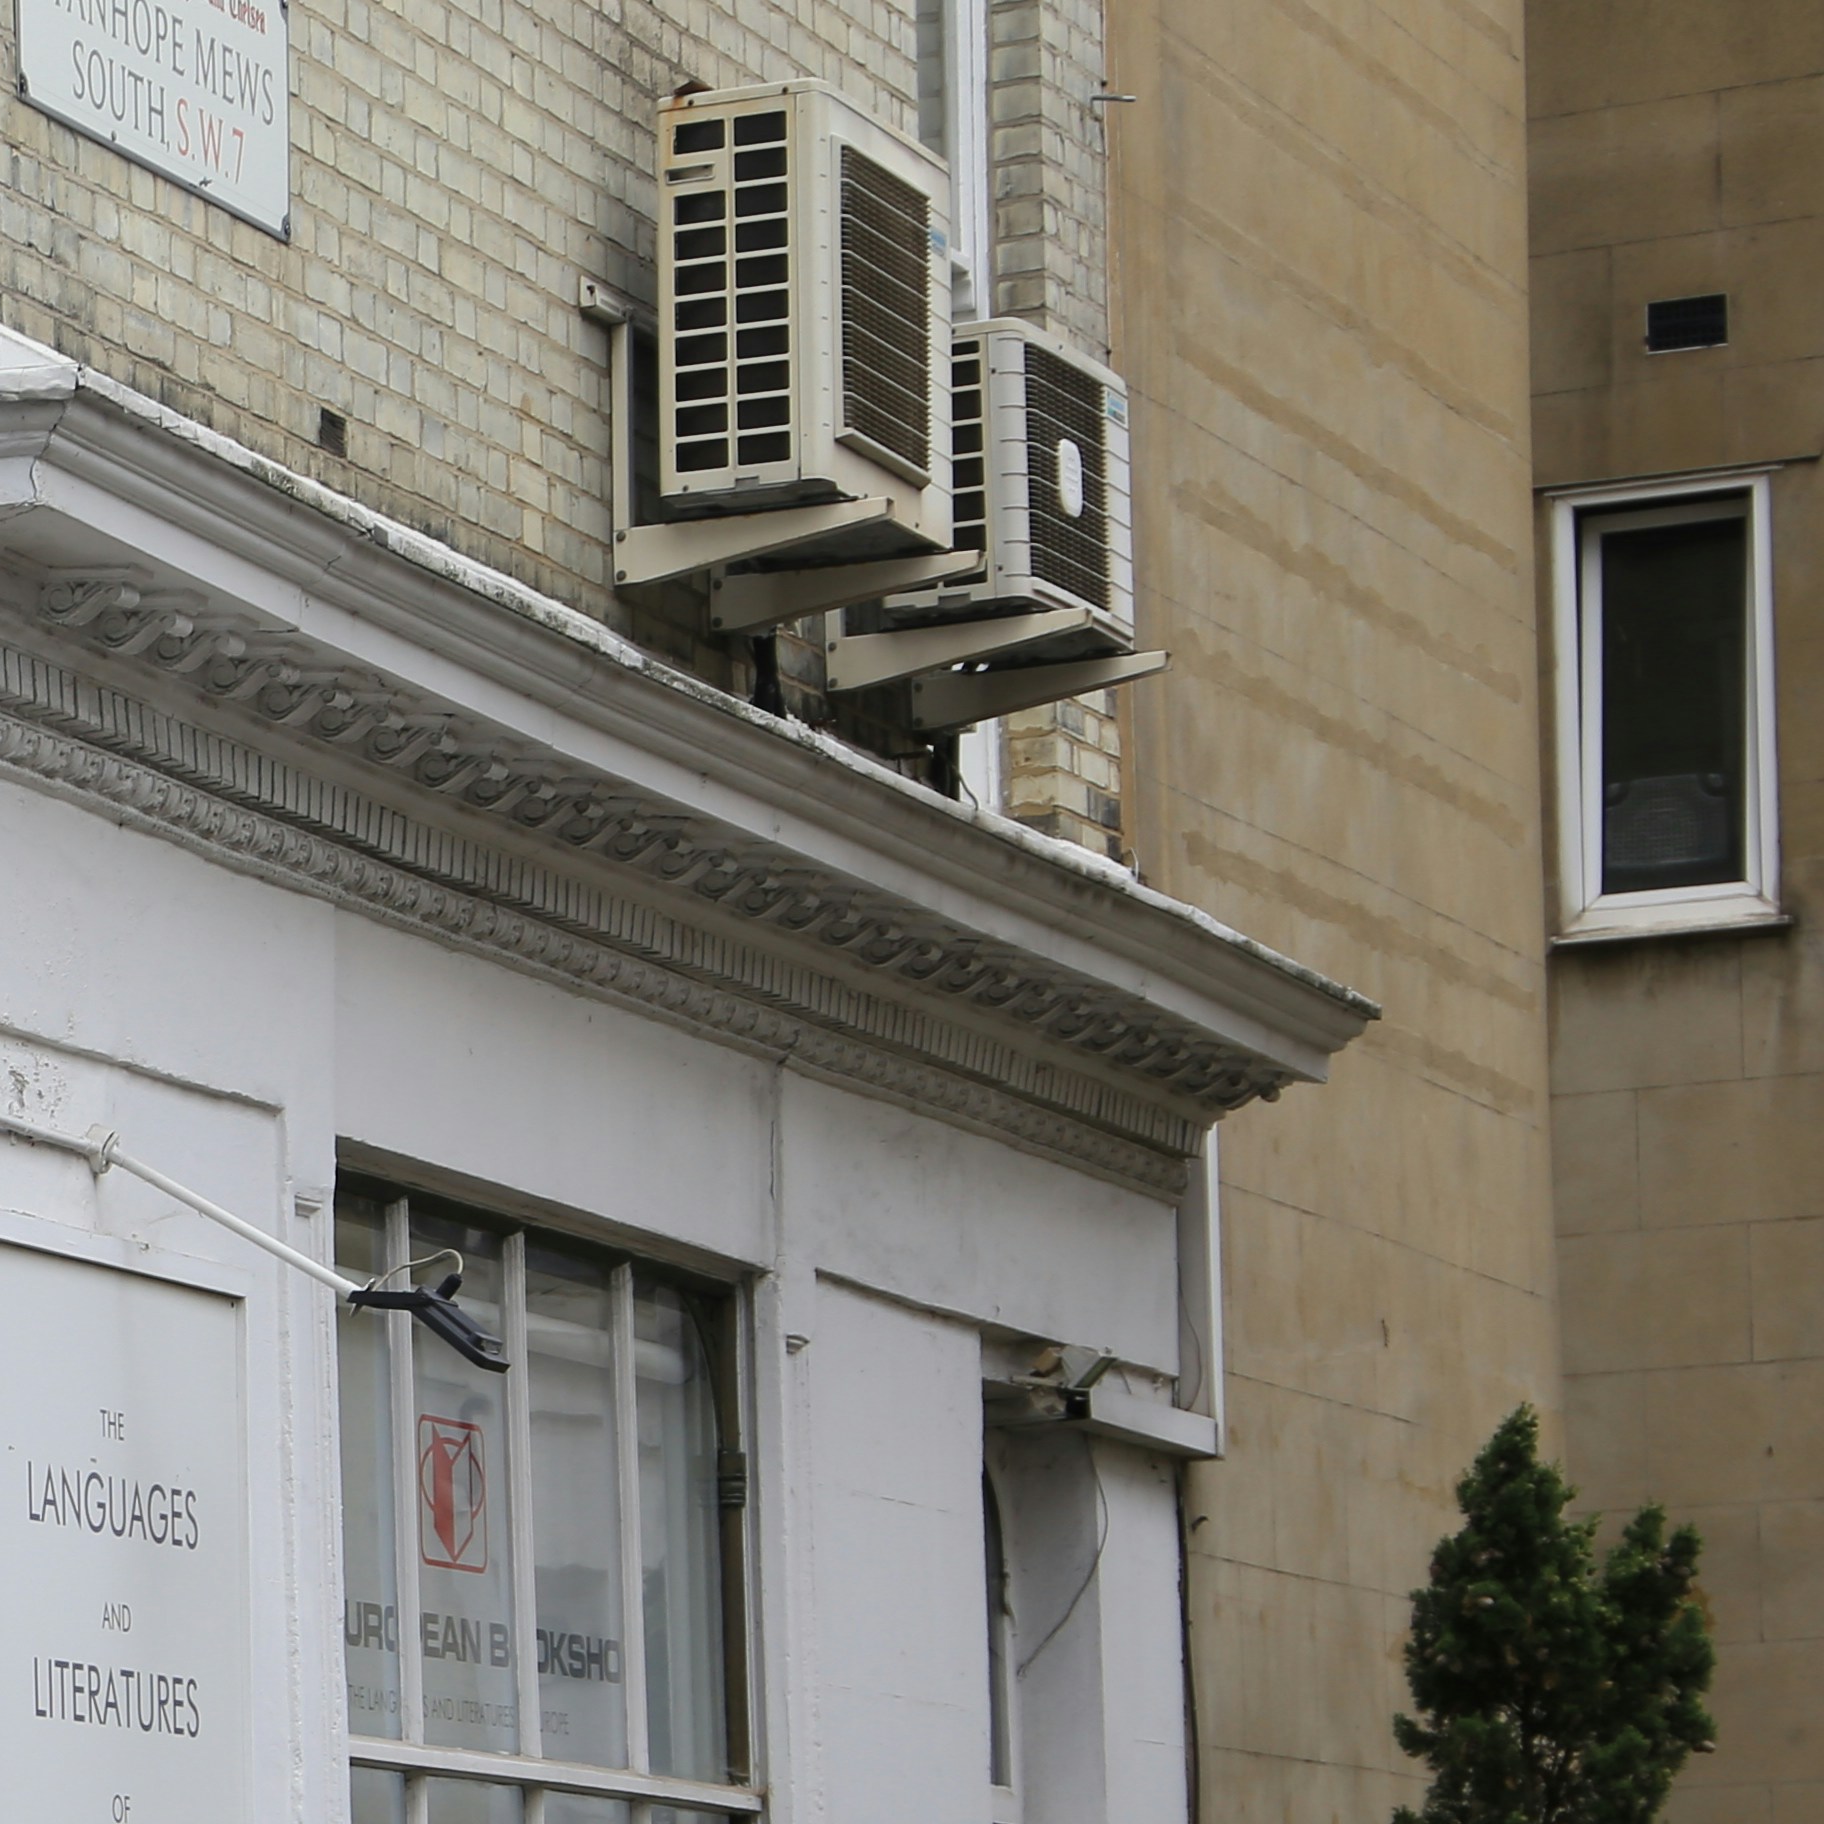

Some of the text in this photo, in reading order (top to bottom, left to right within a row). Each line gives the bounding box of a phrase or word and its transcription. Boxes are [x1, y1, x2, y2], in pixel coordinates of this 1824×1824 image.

[72, 40, 244, 184] SOUTH, S.W.7
[195, 28, 274, 126] MEWS
[100, 1409, 125, 1441] THE
[27, 1461, 199, 1550] LANGUAGES
[101, 1602, 132, 1632] AND
[345, 1600, 623, 1684] UROEAN BOKSHO
[33, 1657, 200, 1738] LITERATURES
[112, 1794, 131, 1823] OF
